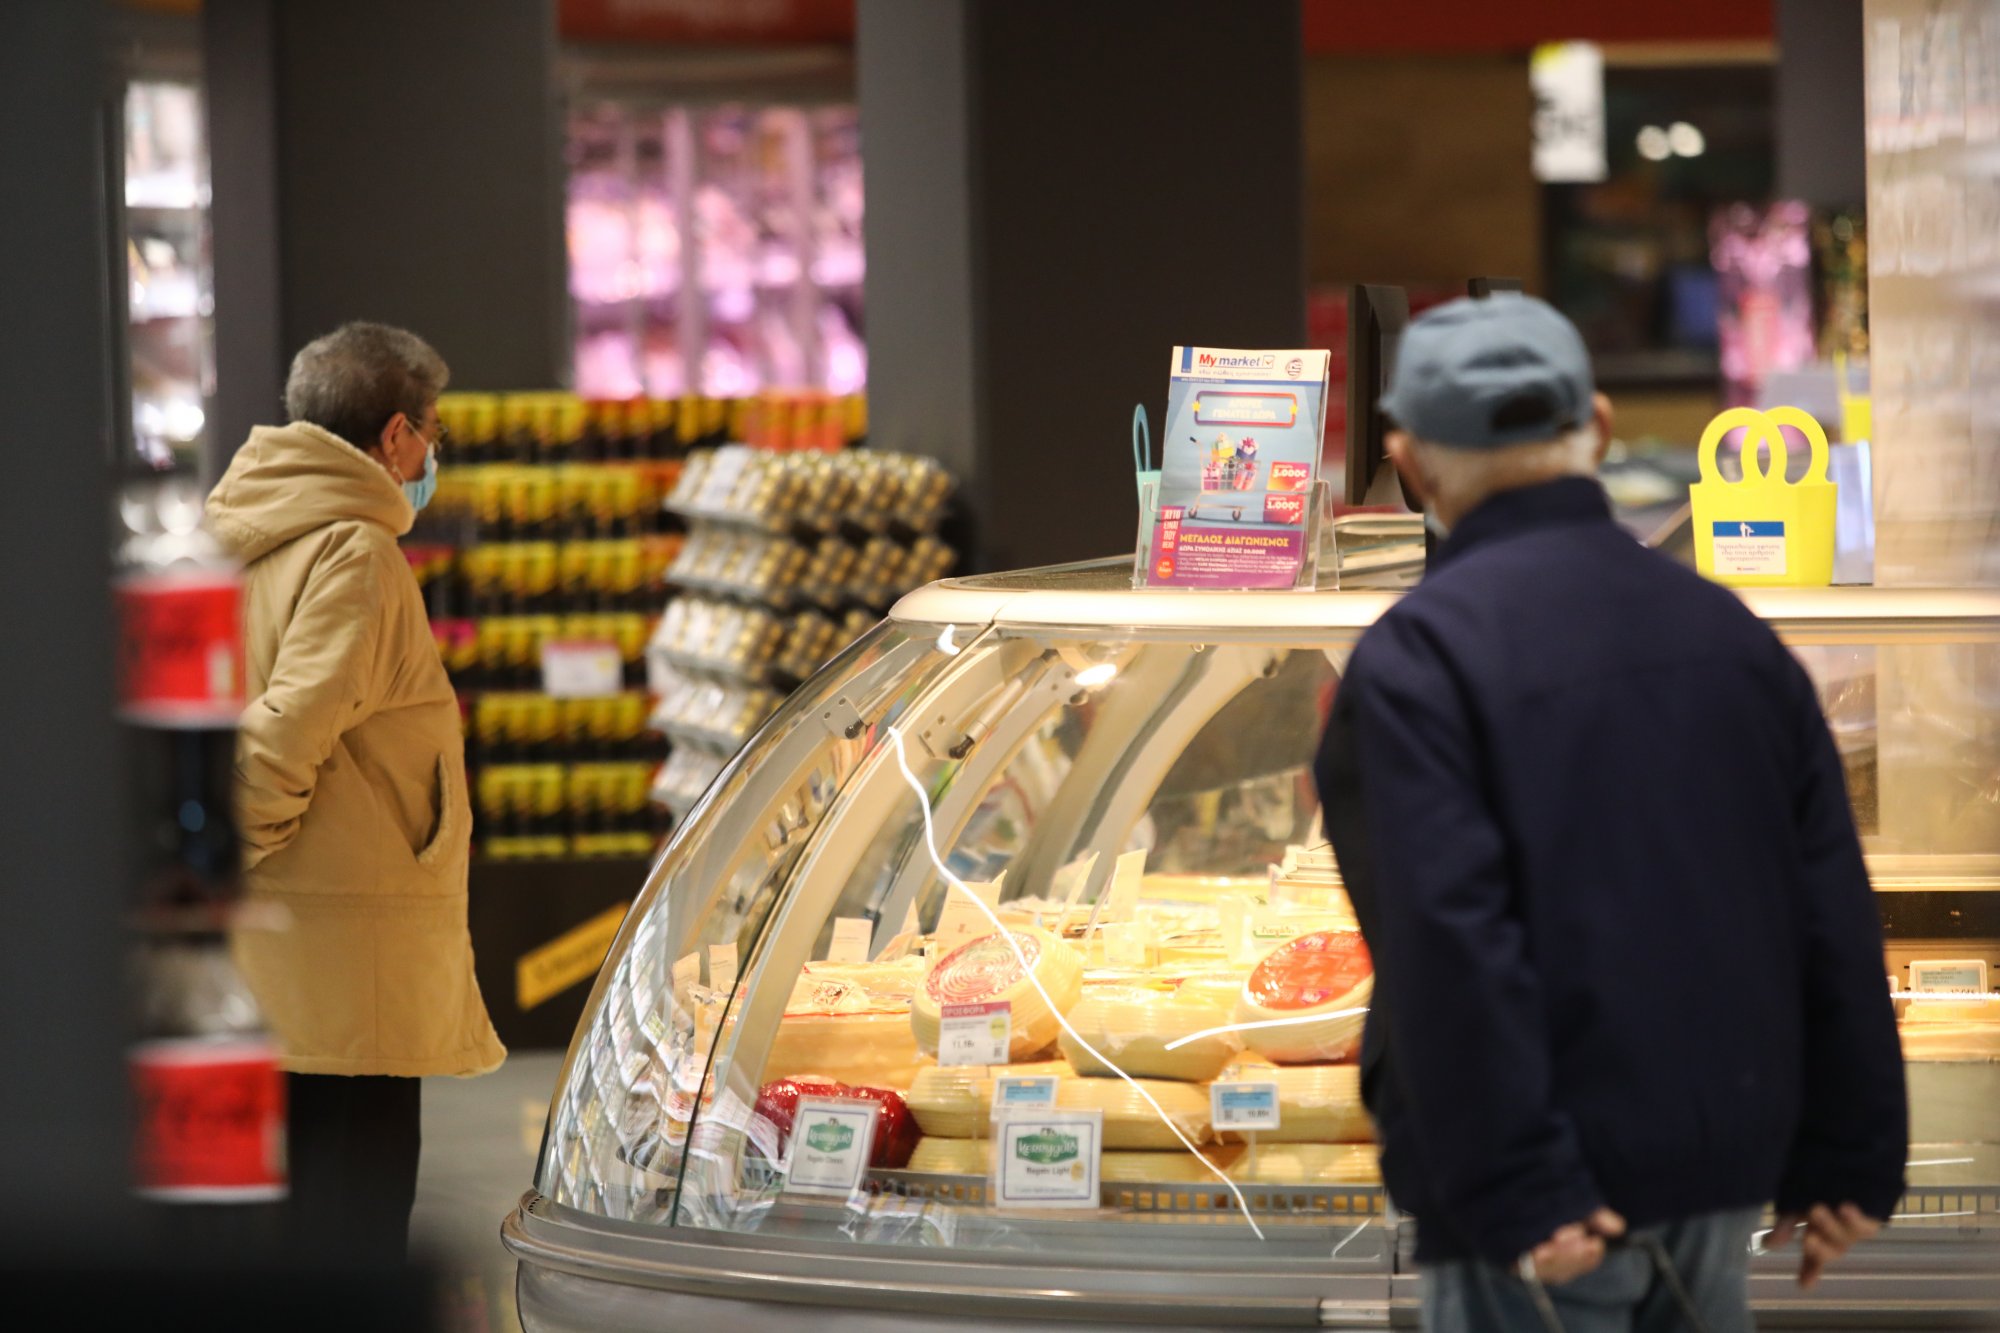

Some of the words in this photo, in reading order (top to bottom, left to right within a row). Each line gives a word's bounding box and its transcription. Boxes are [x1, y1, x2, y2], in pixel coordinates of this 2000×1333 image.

[1199, 353, 1217, 367] My
[1219, 355, 1261, 367] market
[1179, 533, 1222, 545] ΜΕΓΑΛΟΣ
[1224, 535, 1289, 547] ΔΙΑΓΩΝΙΣΜΟΣ
